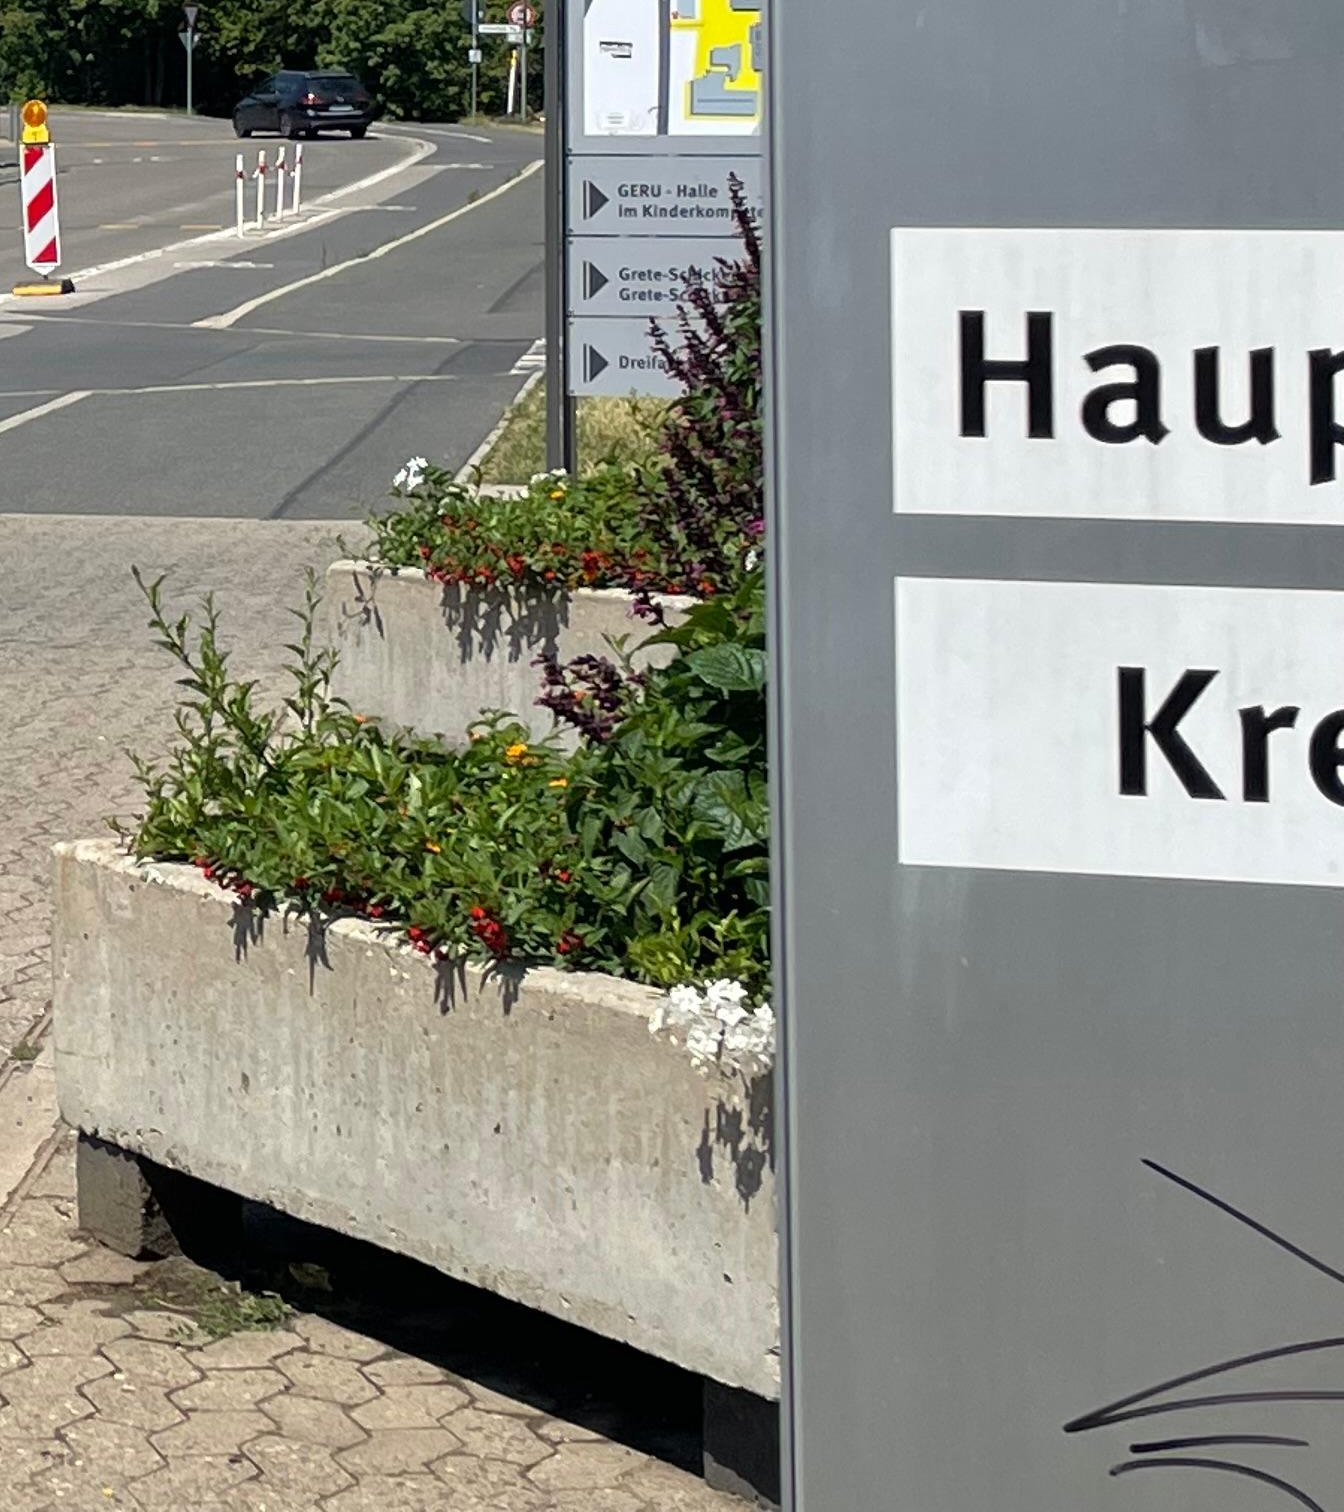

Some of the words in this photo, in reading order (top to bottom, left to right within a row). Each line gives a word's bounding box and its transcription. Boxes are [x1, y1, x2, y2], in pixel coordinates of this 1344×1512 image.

[617, 183, 662, 199] GERU
[676, 183, 719, 199] Halle
[618, 354, 666, 370] Dreifa
